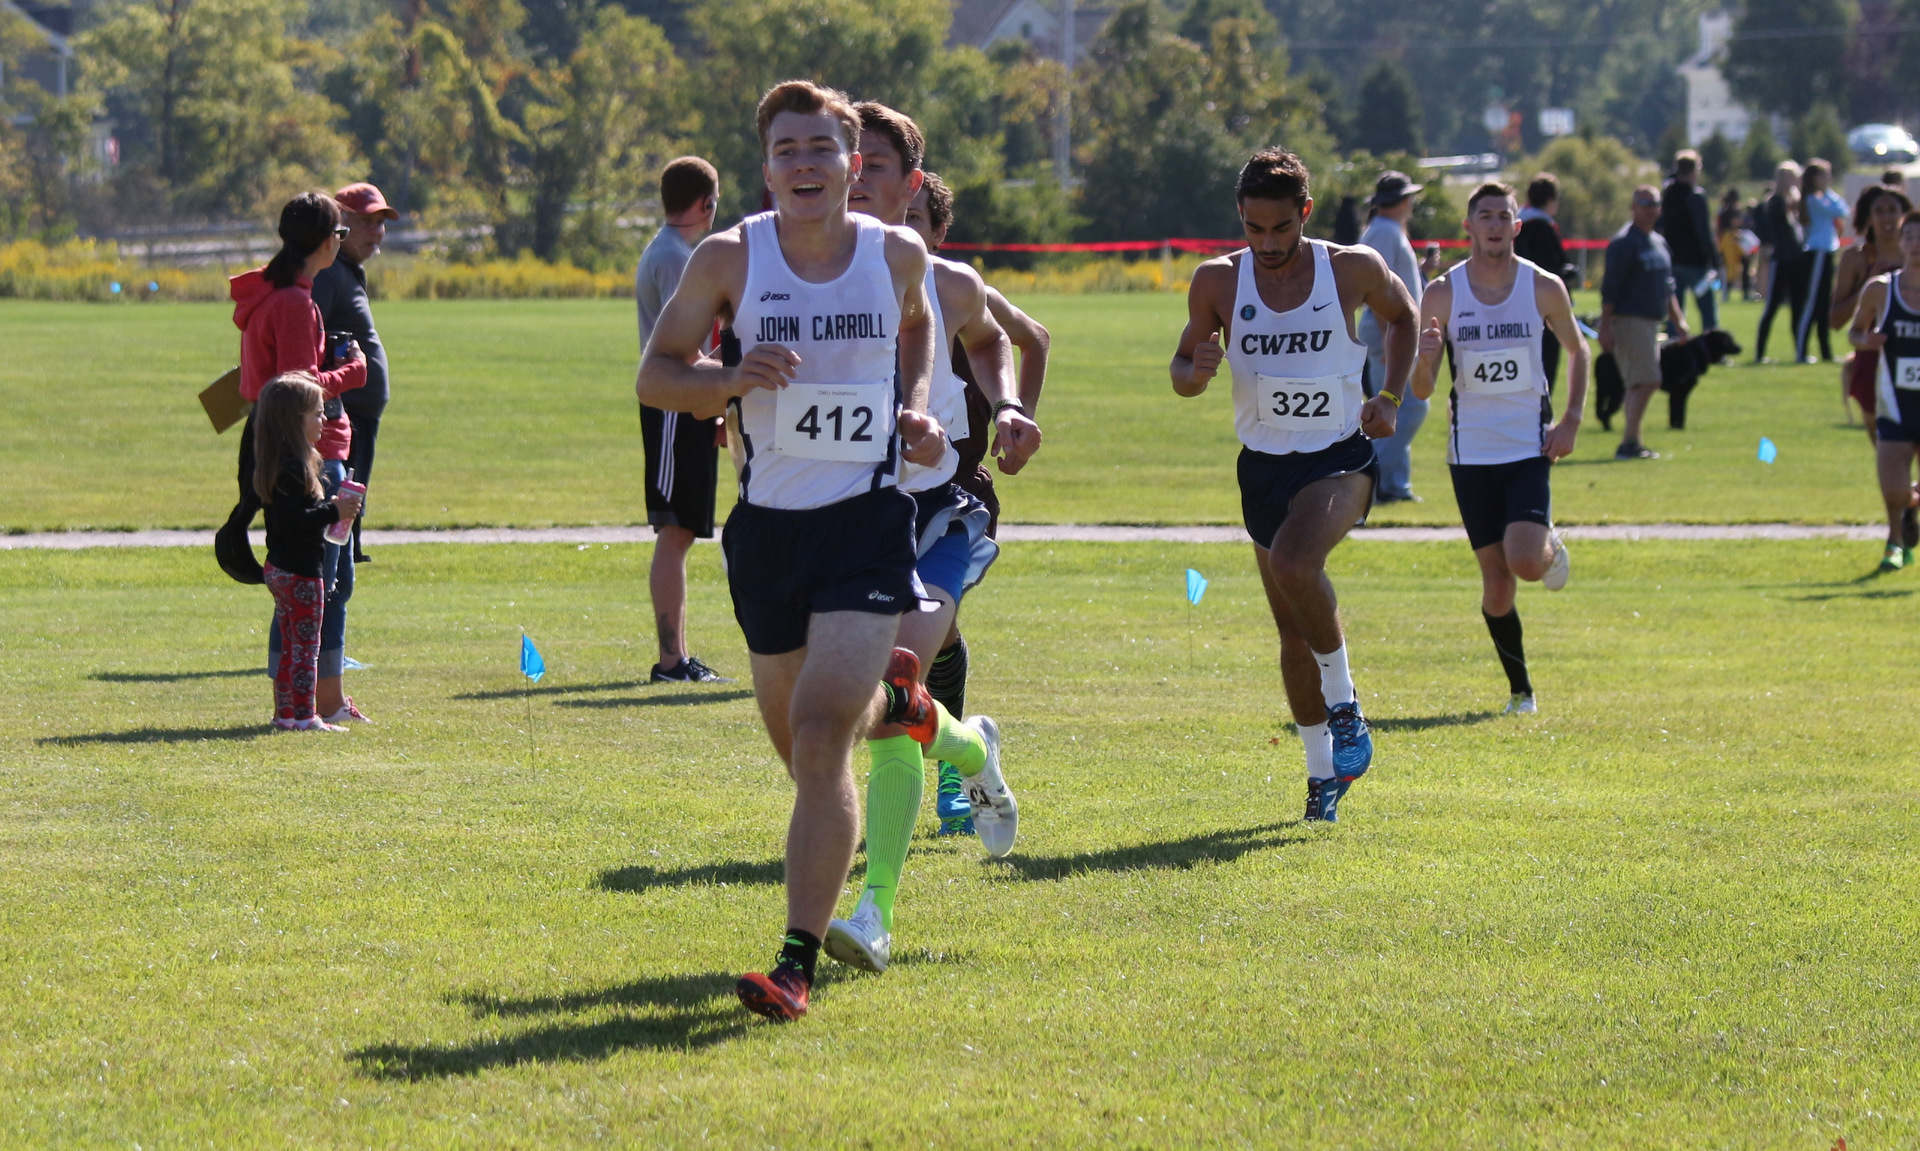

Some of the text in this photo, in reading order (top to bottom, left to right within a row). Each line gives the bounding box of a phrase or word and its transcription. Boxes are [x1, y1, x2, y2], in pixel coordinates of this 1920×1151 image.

[756, 313, 887, 342] JOHN CARROLL
[1456, 322, 1532, 342] JOHN CARROLL
[1241, 330, 1333, 355] CWRU
[1474, 360, 1518, 383] 429
[1272, 391, 1330, 418] 322
[796, 405, 873, 442] 412
